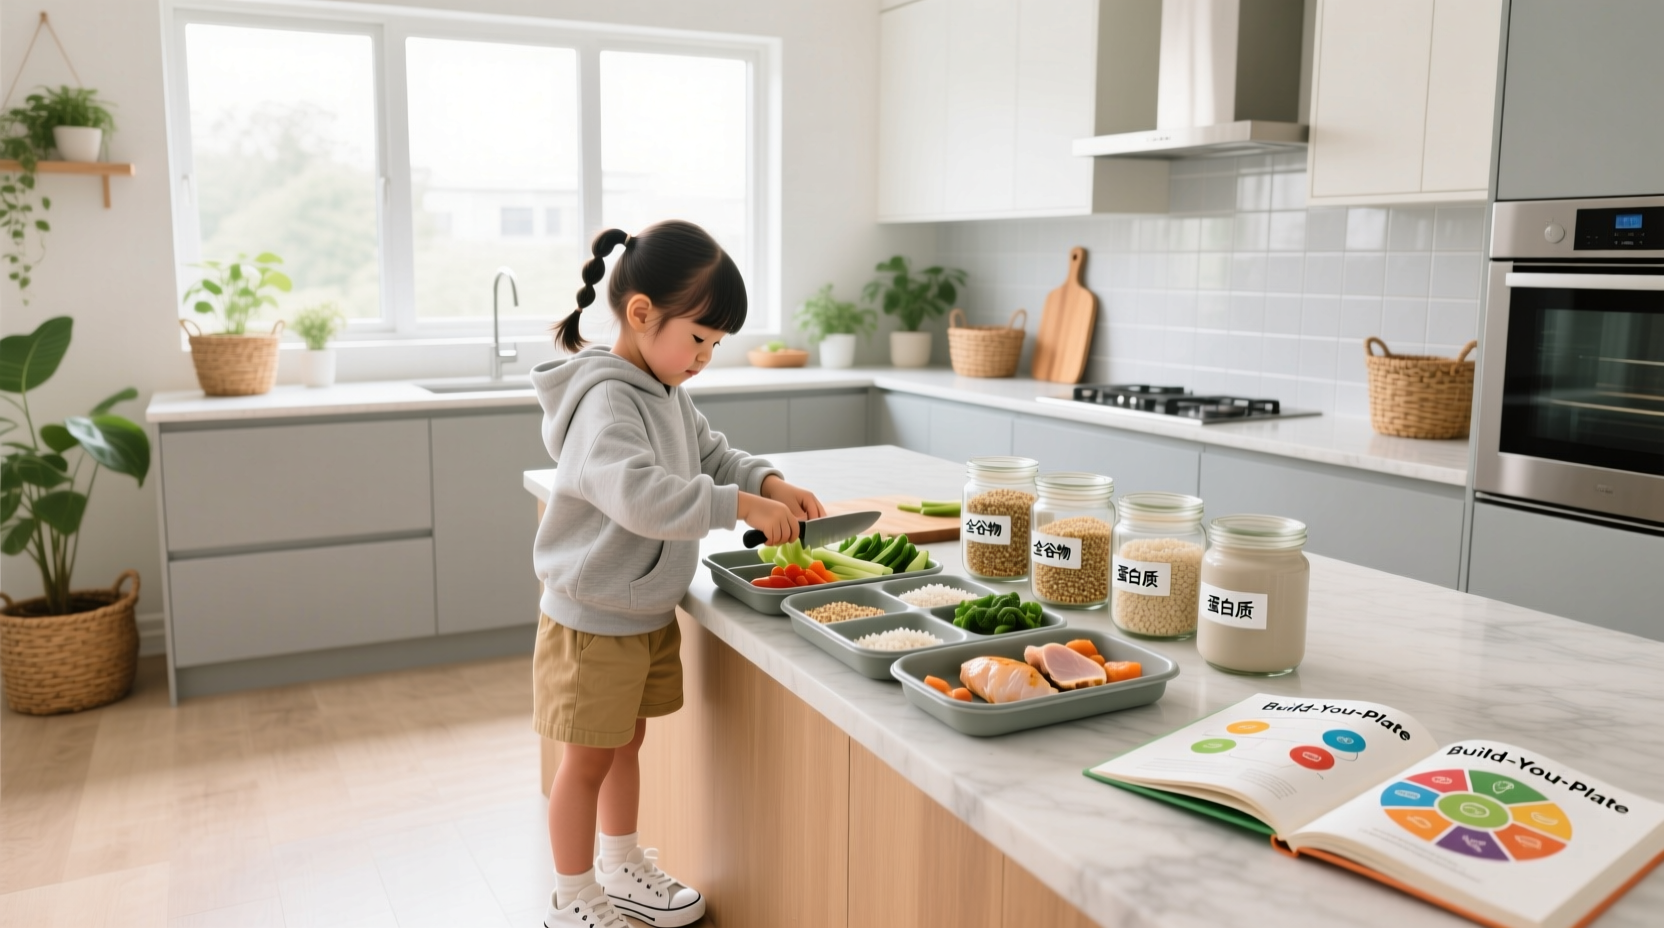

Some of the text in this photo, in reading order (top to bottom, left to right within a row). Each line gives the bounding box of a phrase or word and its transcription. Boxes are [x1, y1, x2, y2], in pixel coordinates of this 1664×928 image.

[1117, 564, 1159, 588] 蛋白质
[1207, 594, 1254, 620] 蛋白质
[1261, 702, 1411, 741] Build-You-Plate
[1446, 745, 1629, 815] Build-You-Plate
